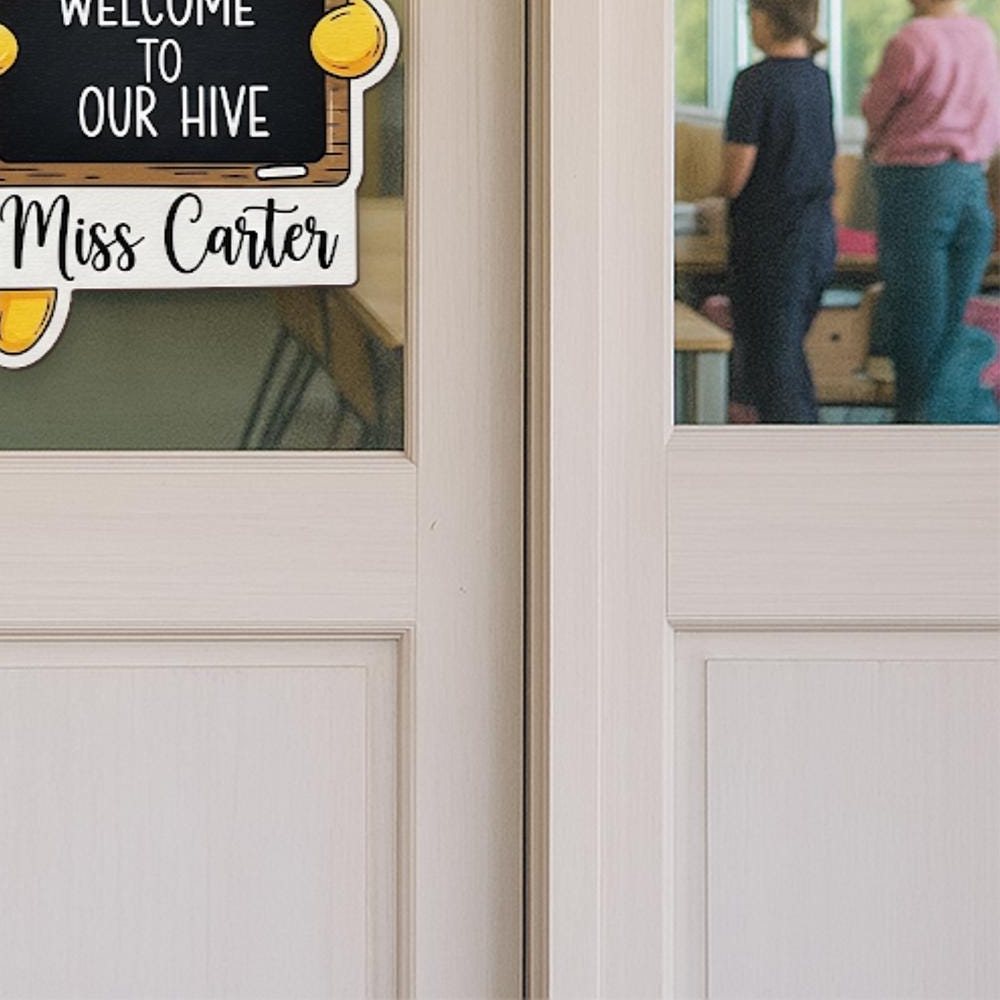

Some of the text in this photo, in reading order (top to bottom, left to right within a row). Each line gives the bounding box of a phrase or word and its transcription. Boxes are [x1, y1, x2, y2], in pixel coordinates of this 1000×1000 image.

[136, 38, 182, 84] TO
[78, 85, 270, 138] OUR HIVE
[164, 192, 339, 274] Carter
